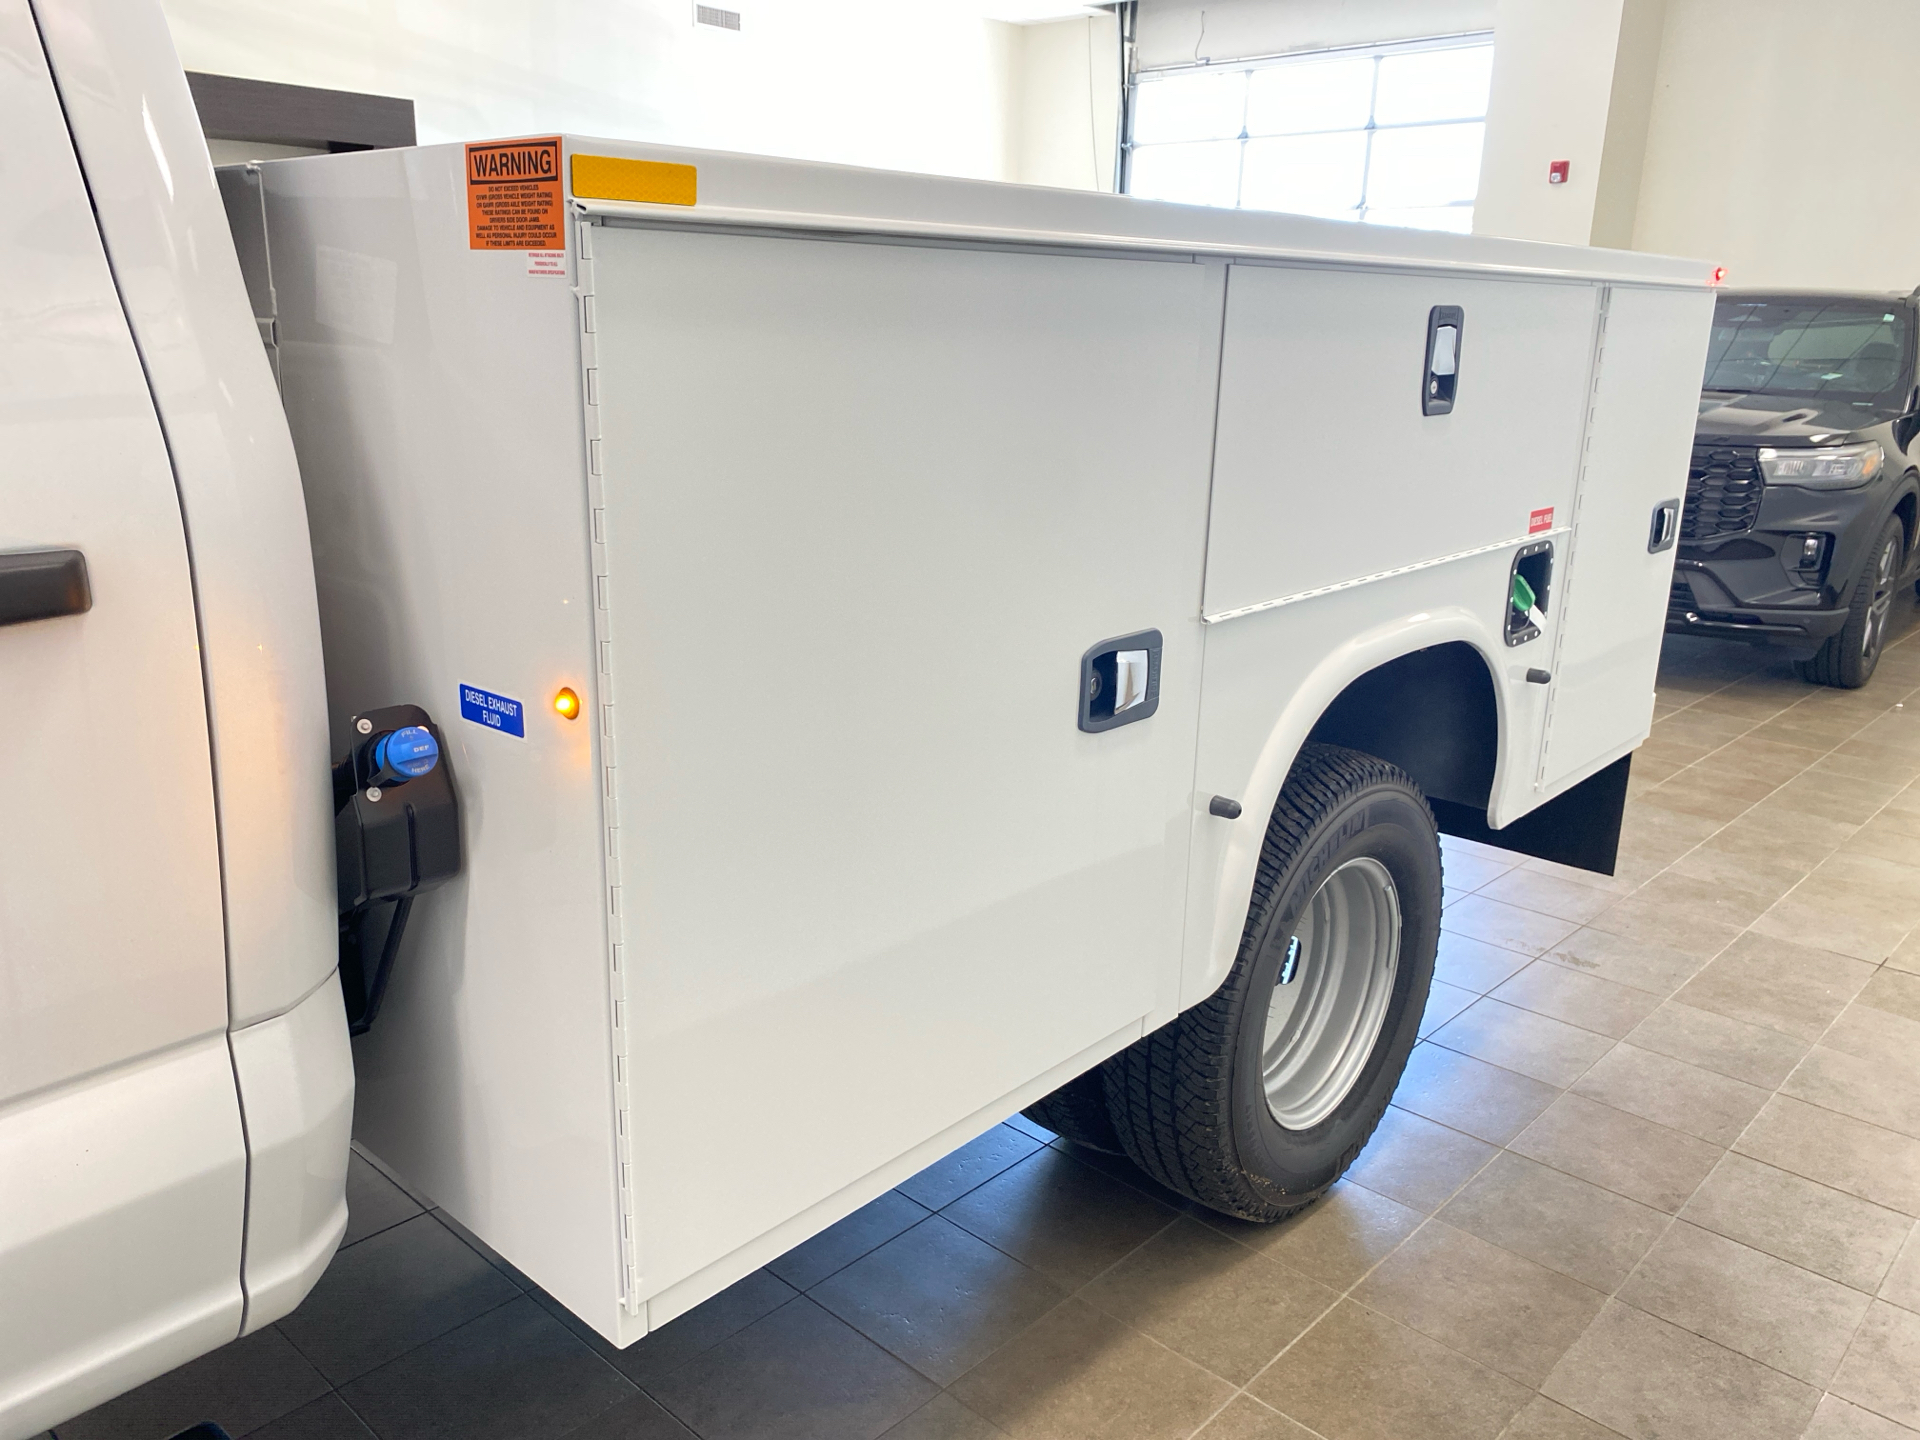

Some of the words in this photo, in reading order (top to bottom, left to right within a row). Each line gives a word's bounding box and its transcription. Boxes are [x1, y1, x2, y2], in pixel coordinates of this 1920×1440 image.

[474, 149, 552, 177] WARNING
[1530, 515, 1543, 527] DIESEL
[465, 689, 487, 707] DIESEL
[488, 696, 517, 717] EXHAUST
[482, 709, 502, 727] FLUID
[401, 729, 418, 738] FILL
[413, 744, 430, 753] DEF
[411, 764, 430, 773] HERE
[1290, 808, 1367, 914] MICHELIN
